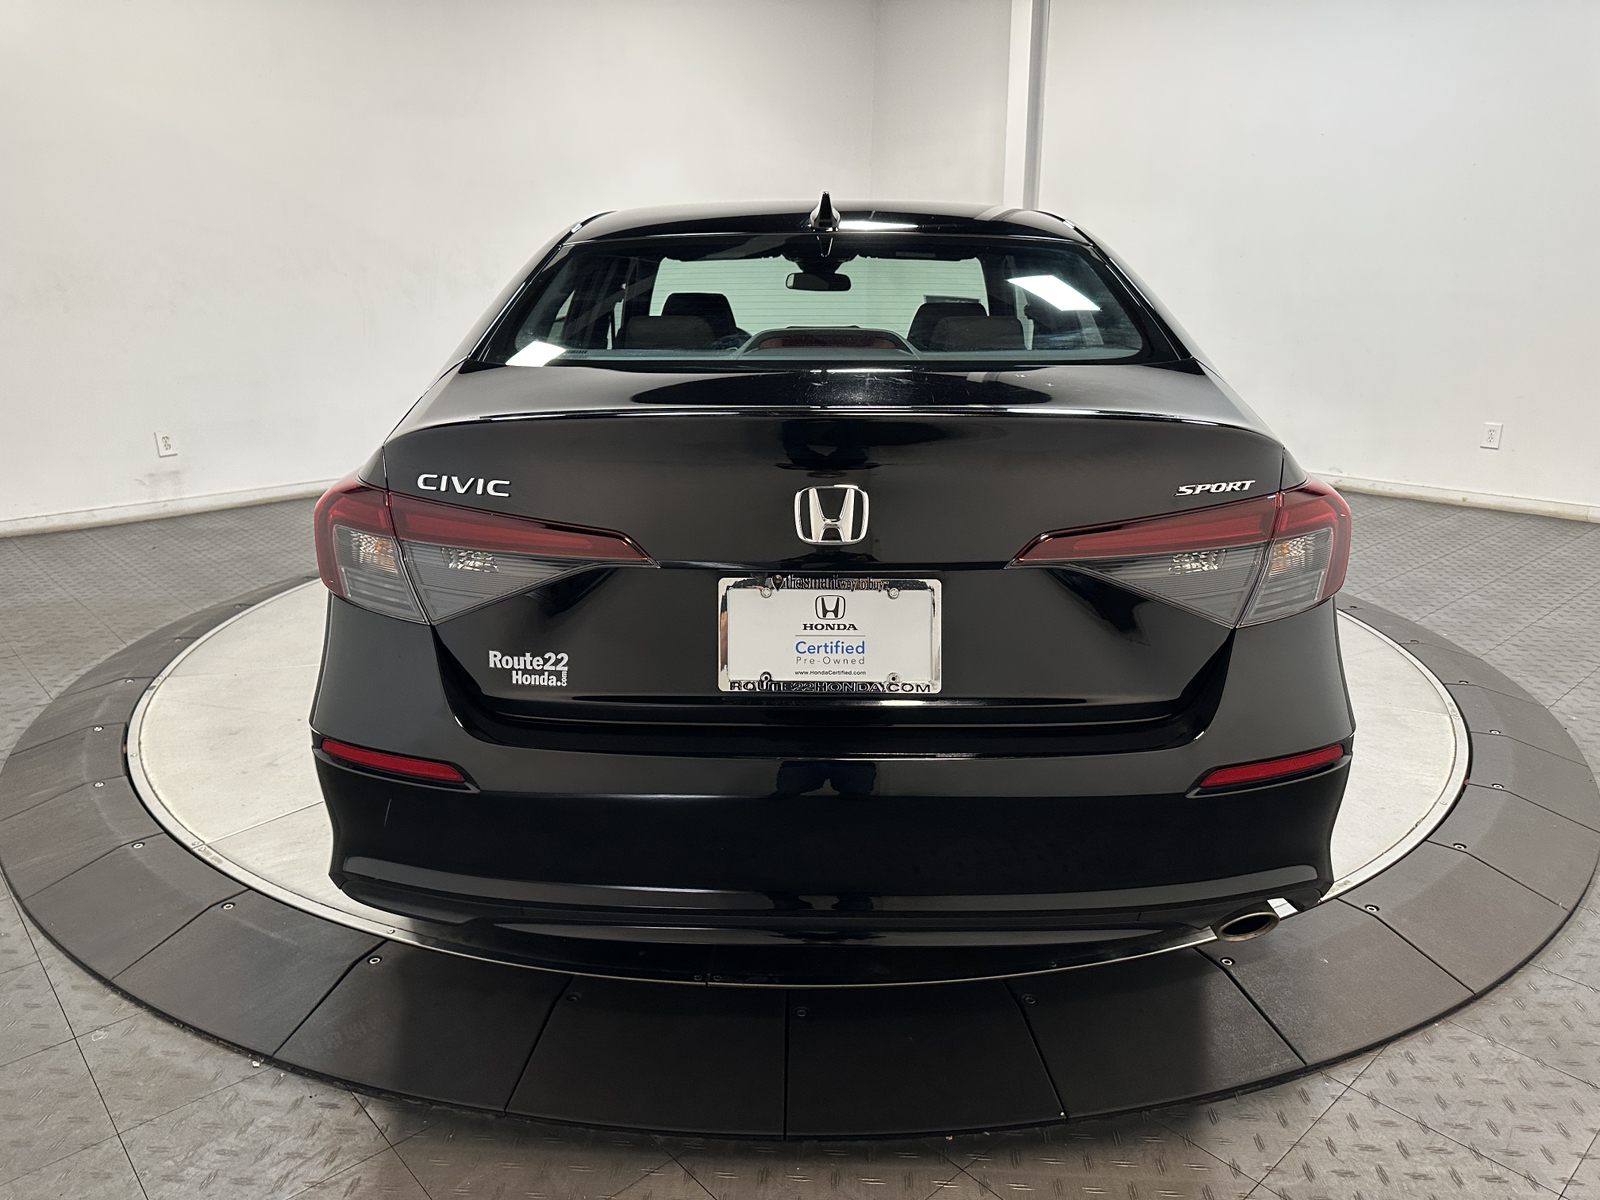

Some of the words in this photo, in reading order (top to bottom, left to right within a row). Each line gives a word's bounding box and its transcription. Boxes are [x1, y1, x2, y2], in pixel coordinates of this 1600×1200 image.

[417, 473, 511, 498] CIVIC
[1174, 480, 1256, 497] SPORT
[802, 623, 858, 631] HONDA
[795, 640, 865, 655] Certified
[488, 650, 569, 671] Route22
[796, 656, 865, 665] Pre-Owned
[794, 669, 867, 677] www.HondaCertified.com
